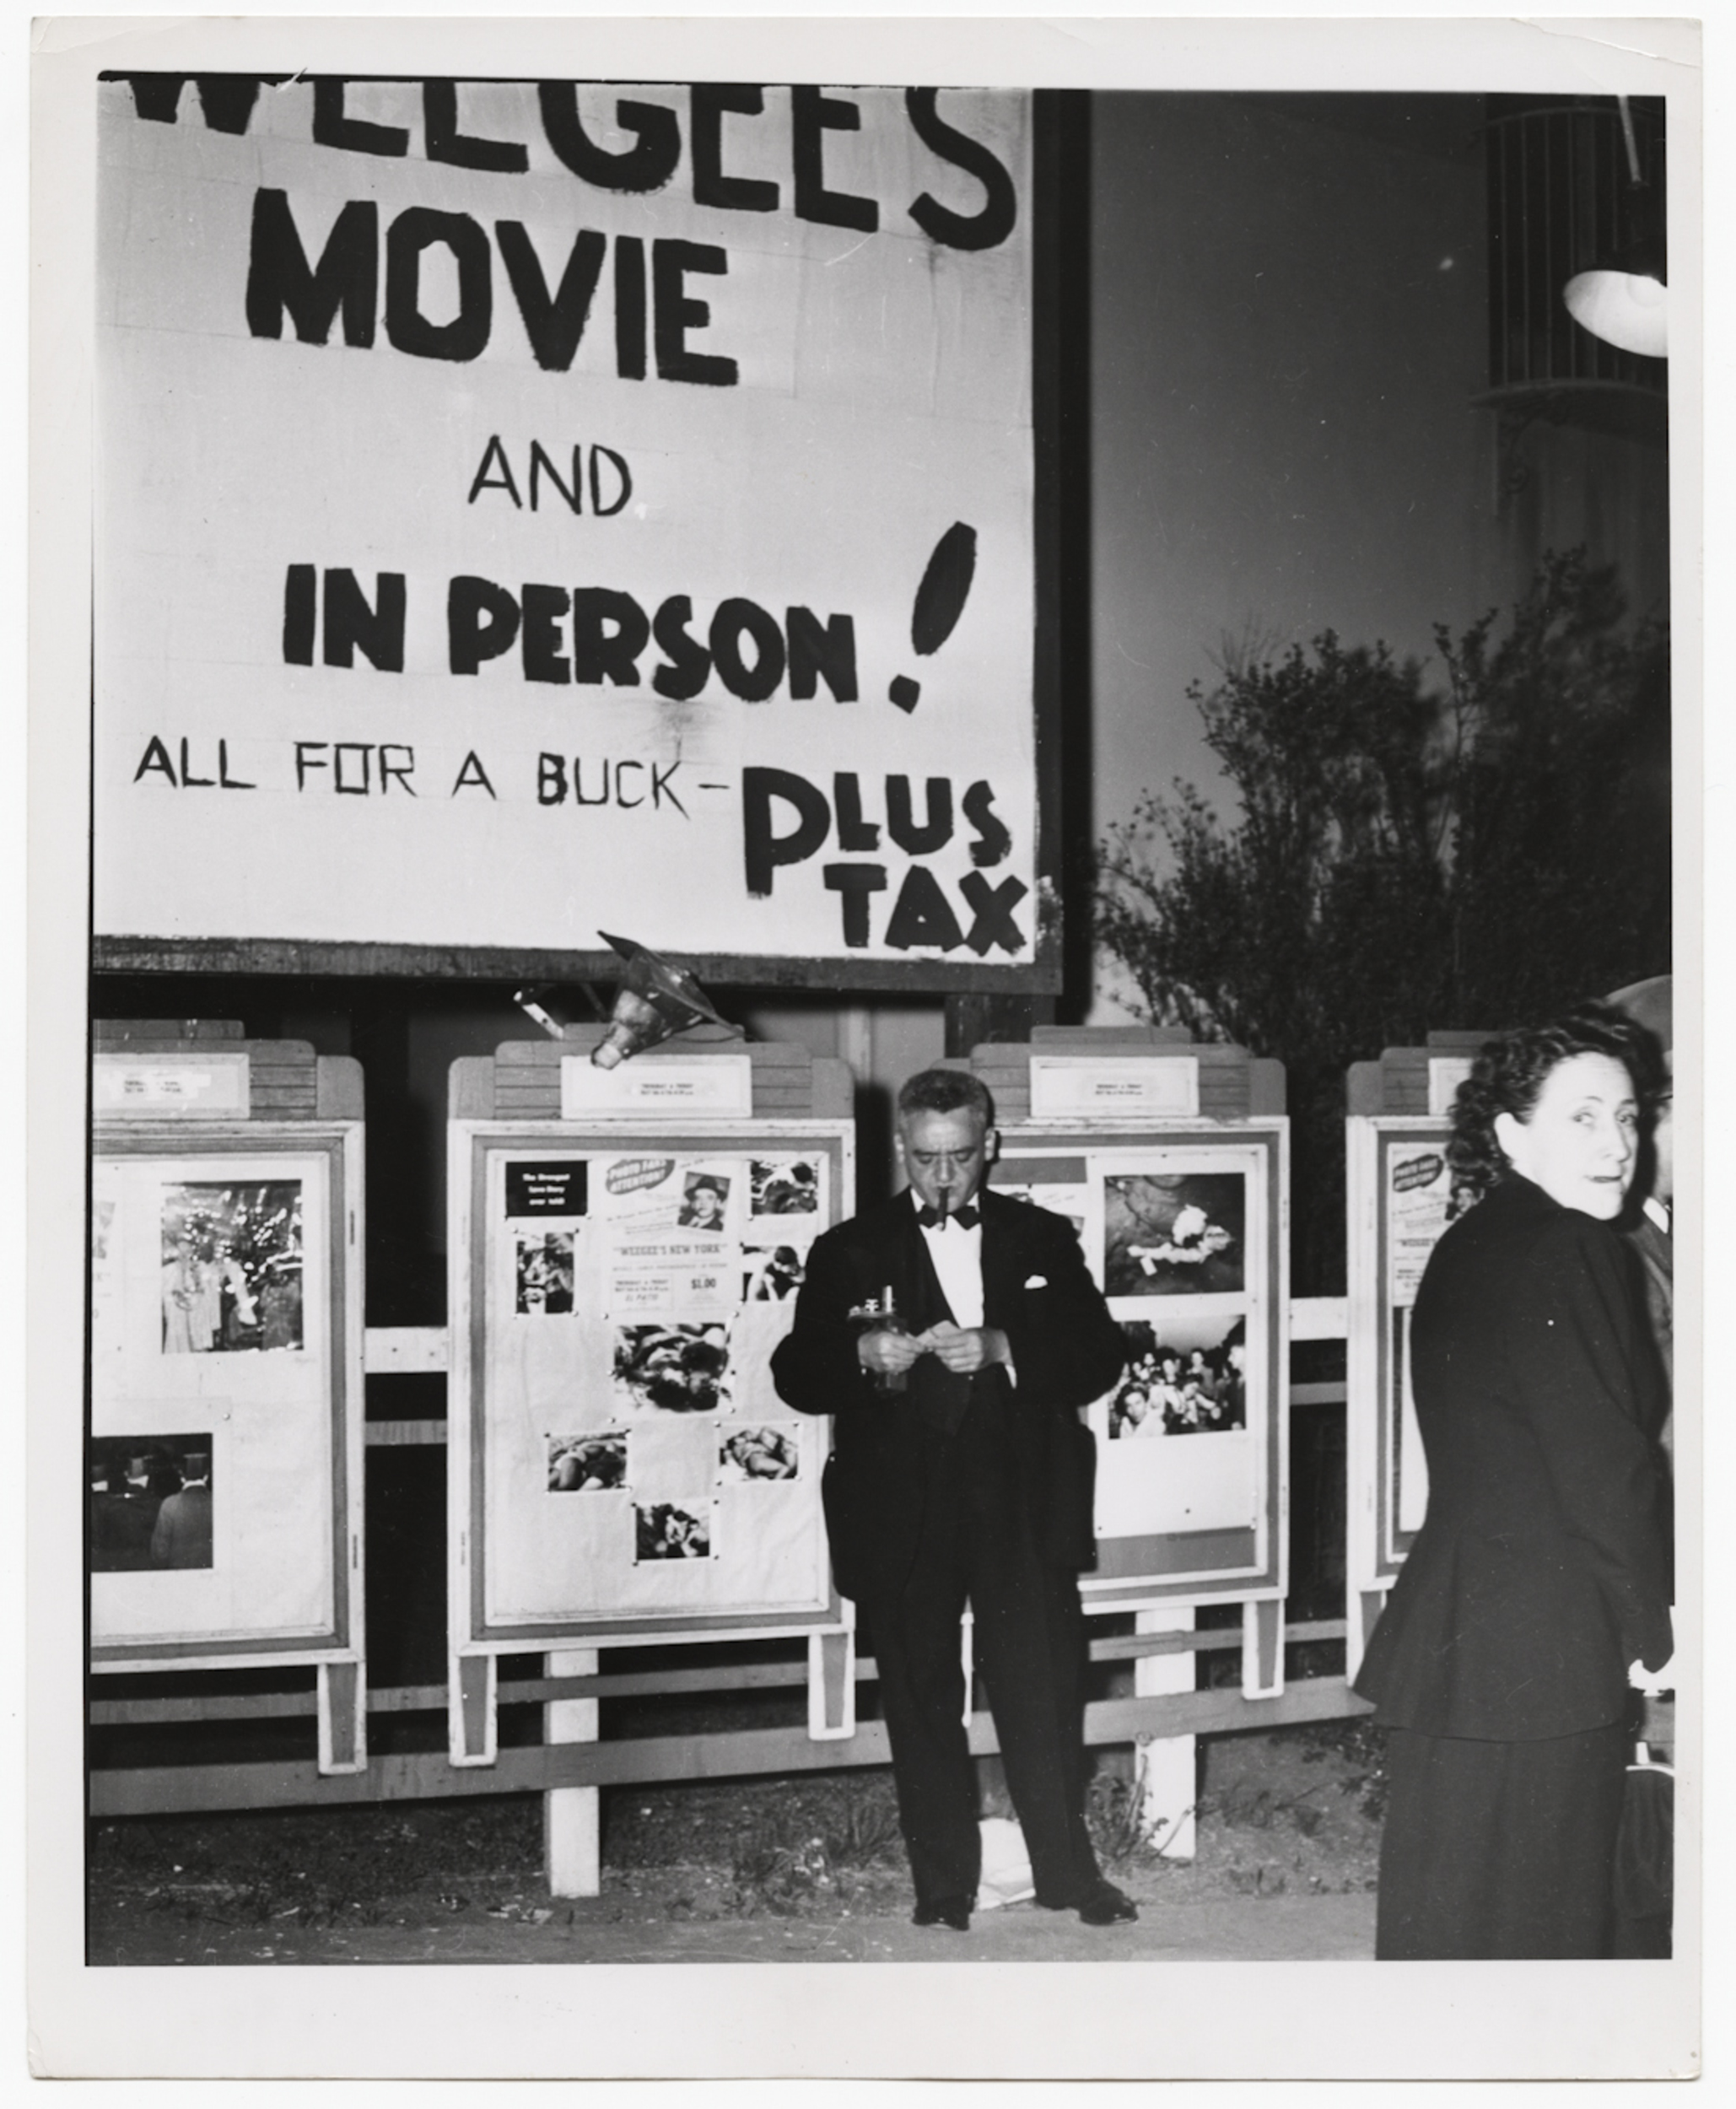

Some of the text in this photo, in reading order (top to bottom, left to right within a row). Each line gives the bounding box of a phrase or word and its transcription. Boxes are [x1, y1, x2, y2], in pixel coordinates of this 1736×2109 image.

[128, 80, 1017, 251] GEES
[245, 187, 740, 387] MOVIE
[467, 434, 633, 517] AND
[283, 564, 407, 674] IN
[133, 735, 256, 790] ALL
[294, 742, 416, 796] FOR
[451, 750, 497, 800] A
[742, 767, 1012, 900] PLUS
[822, 863, 1030, 957] TAX
